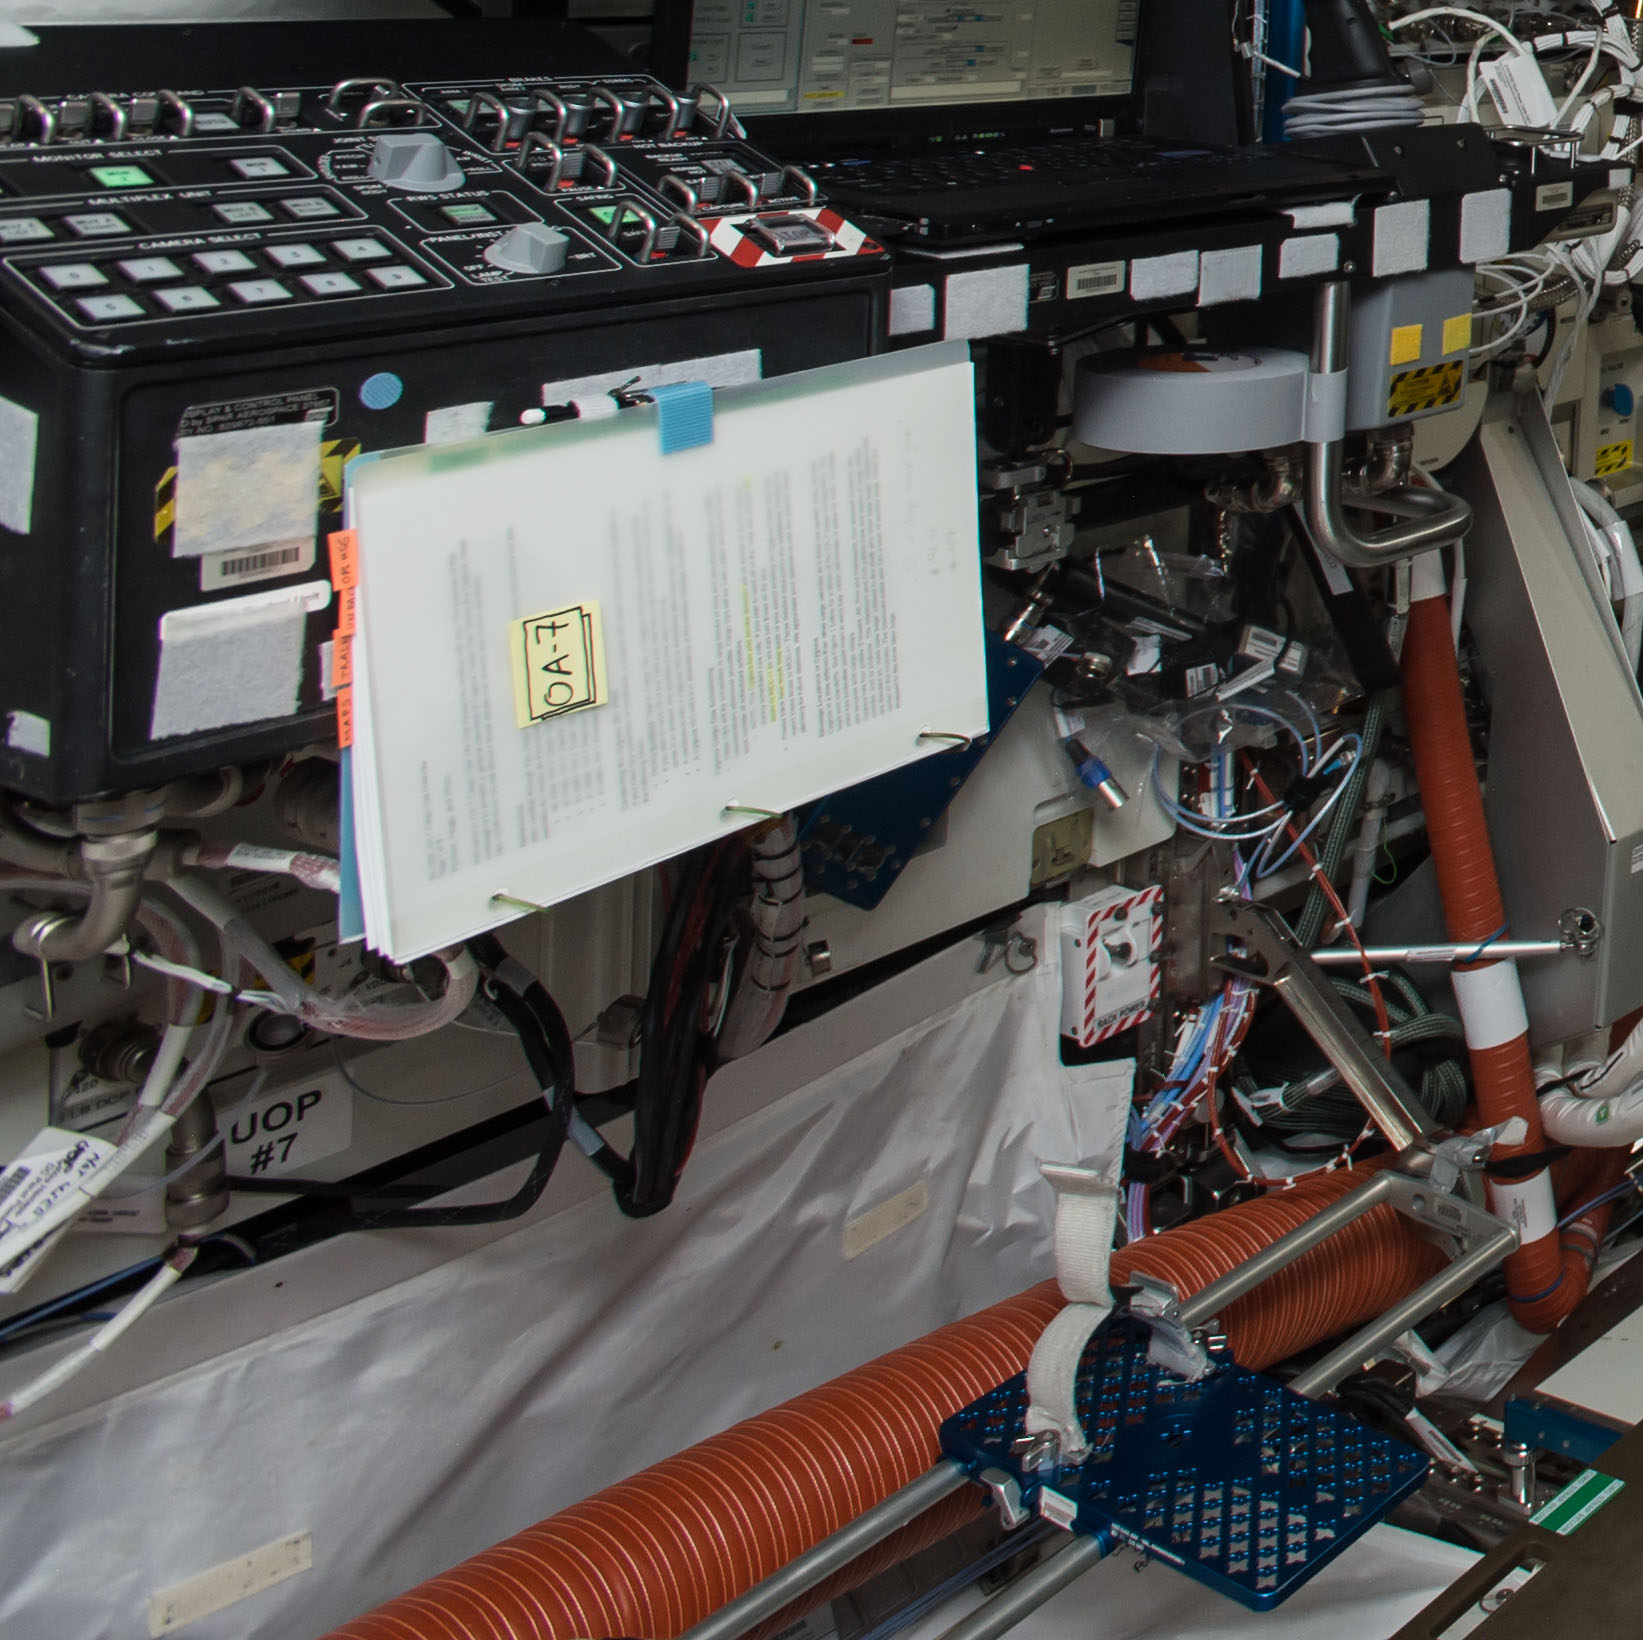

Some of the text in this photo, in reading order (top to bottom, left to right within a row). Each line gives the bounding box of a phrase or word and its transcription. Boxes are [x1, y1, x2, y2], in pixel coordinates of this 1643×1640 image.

[33, 148, 162, 164] MONITOR SELECT
[137, 231, 261, 250] CAMERA SELECT
[542, 617, 575, 710] OA-7
[231, 1088, 323, 1146] UOP
[249, 1132, 298, 1175] #7
